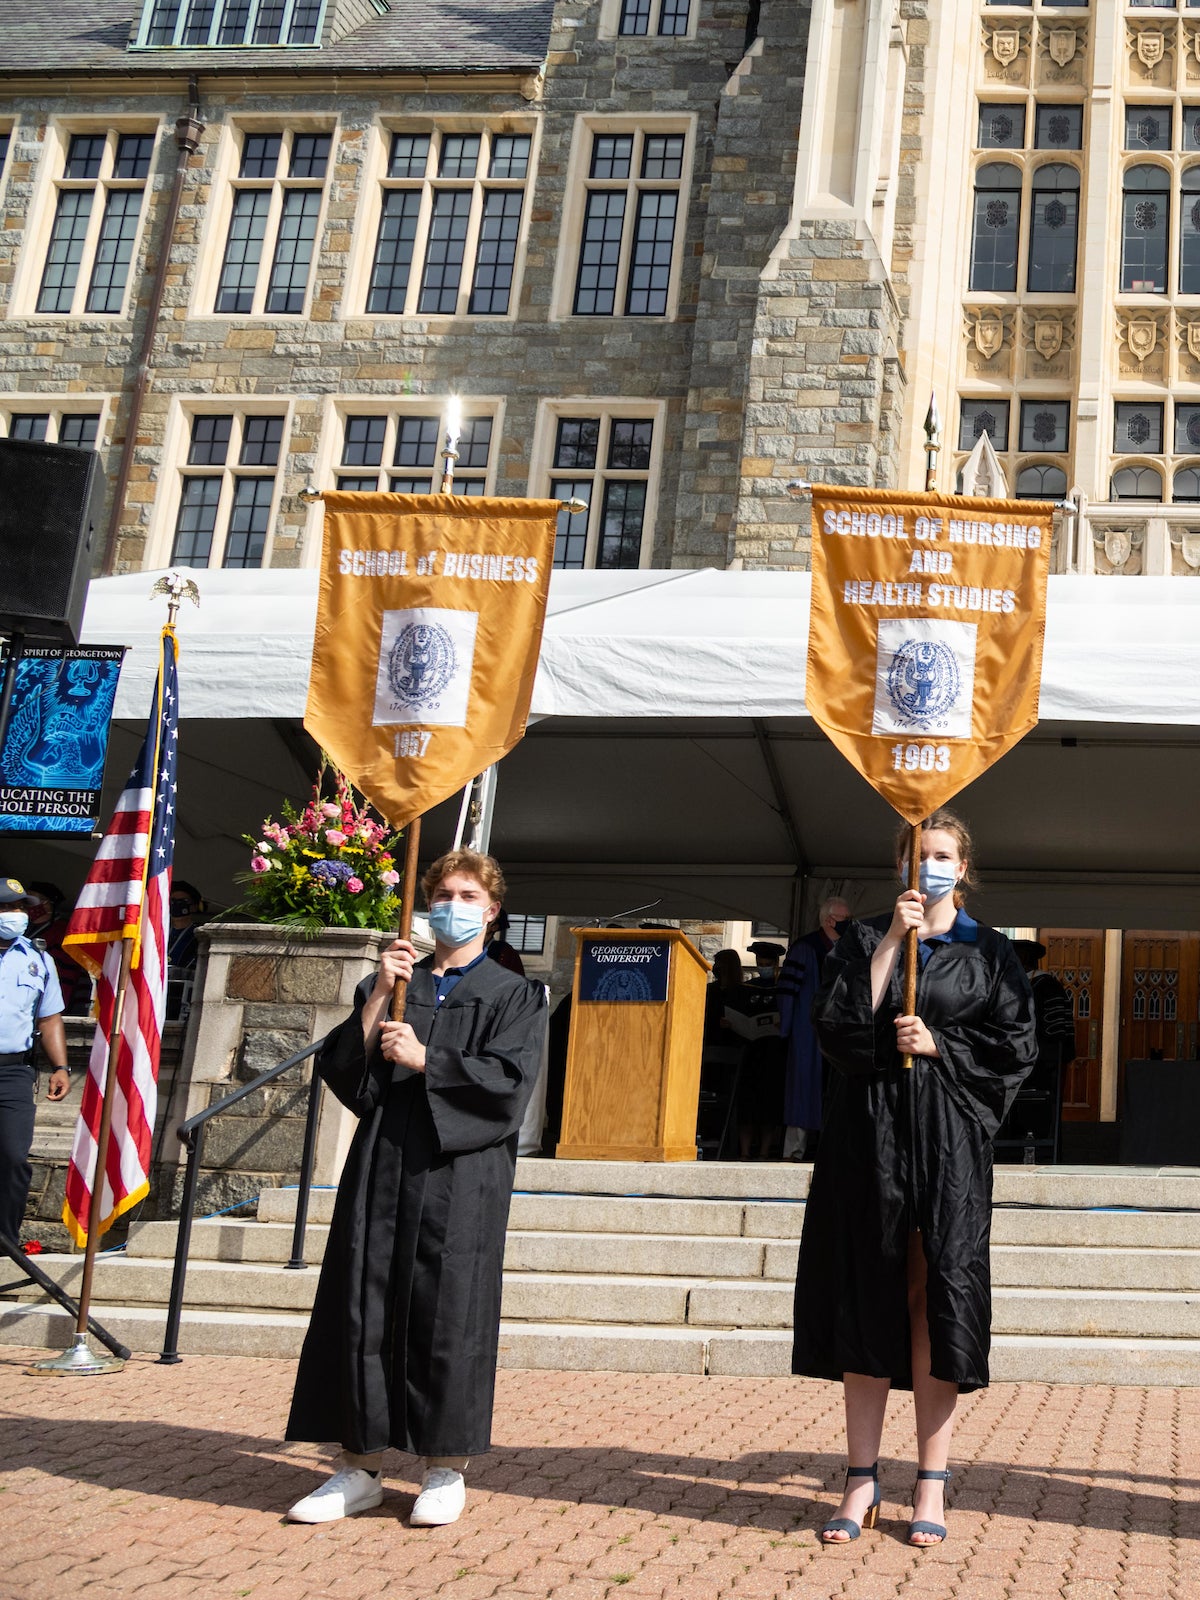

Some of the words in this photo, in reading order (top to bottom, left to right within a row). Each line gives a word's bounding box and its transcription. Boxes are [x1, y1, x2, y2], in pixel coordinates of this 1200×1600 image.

[823, 510, 910, 540] SCHOOL
[914, 516, 943, 541] OF
[949, 519, 1041, 549] NURSING
[338, 549, 410, 577] SCHOOL
[416, 551, 436, 577] of
[442, 553, 539, 584] BUSINESS
[909, 550, 953, 575] AND
[843, 580, 922, 607] HEALTH
[926, 582, 1016, 614] STUDIES
[23, 648, 49, 657] SPIRIT
[50, 649, 62, 657] OF
[65, 649, 122, 658] GEORGETOWN
[394, 731, 433, 758] 1957
[891, 743, 951, 772] 1903
[0, 788, 65, 802] UCATING
[67, 791, 95, 804] THE
[36, 802, 91, 816] PERSON
[591, 946, 662, 957] GEORGETOWN
[597, 955, 653, 963] UNIVERSITY
